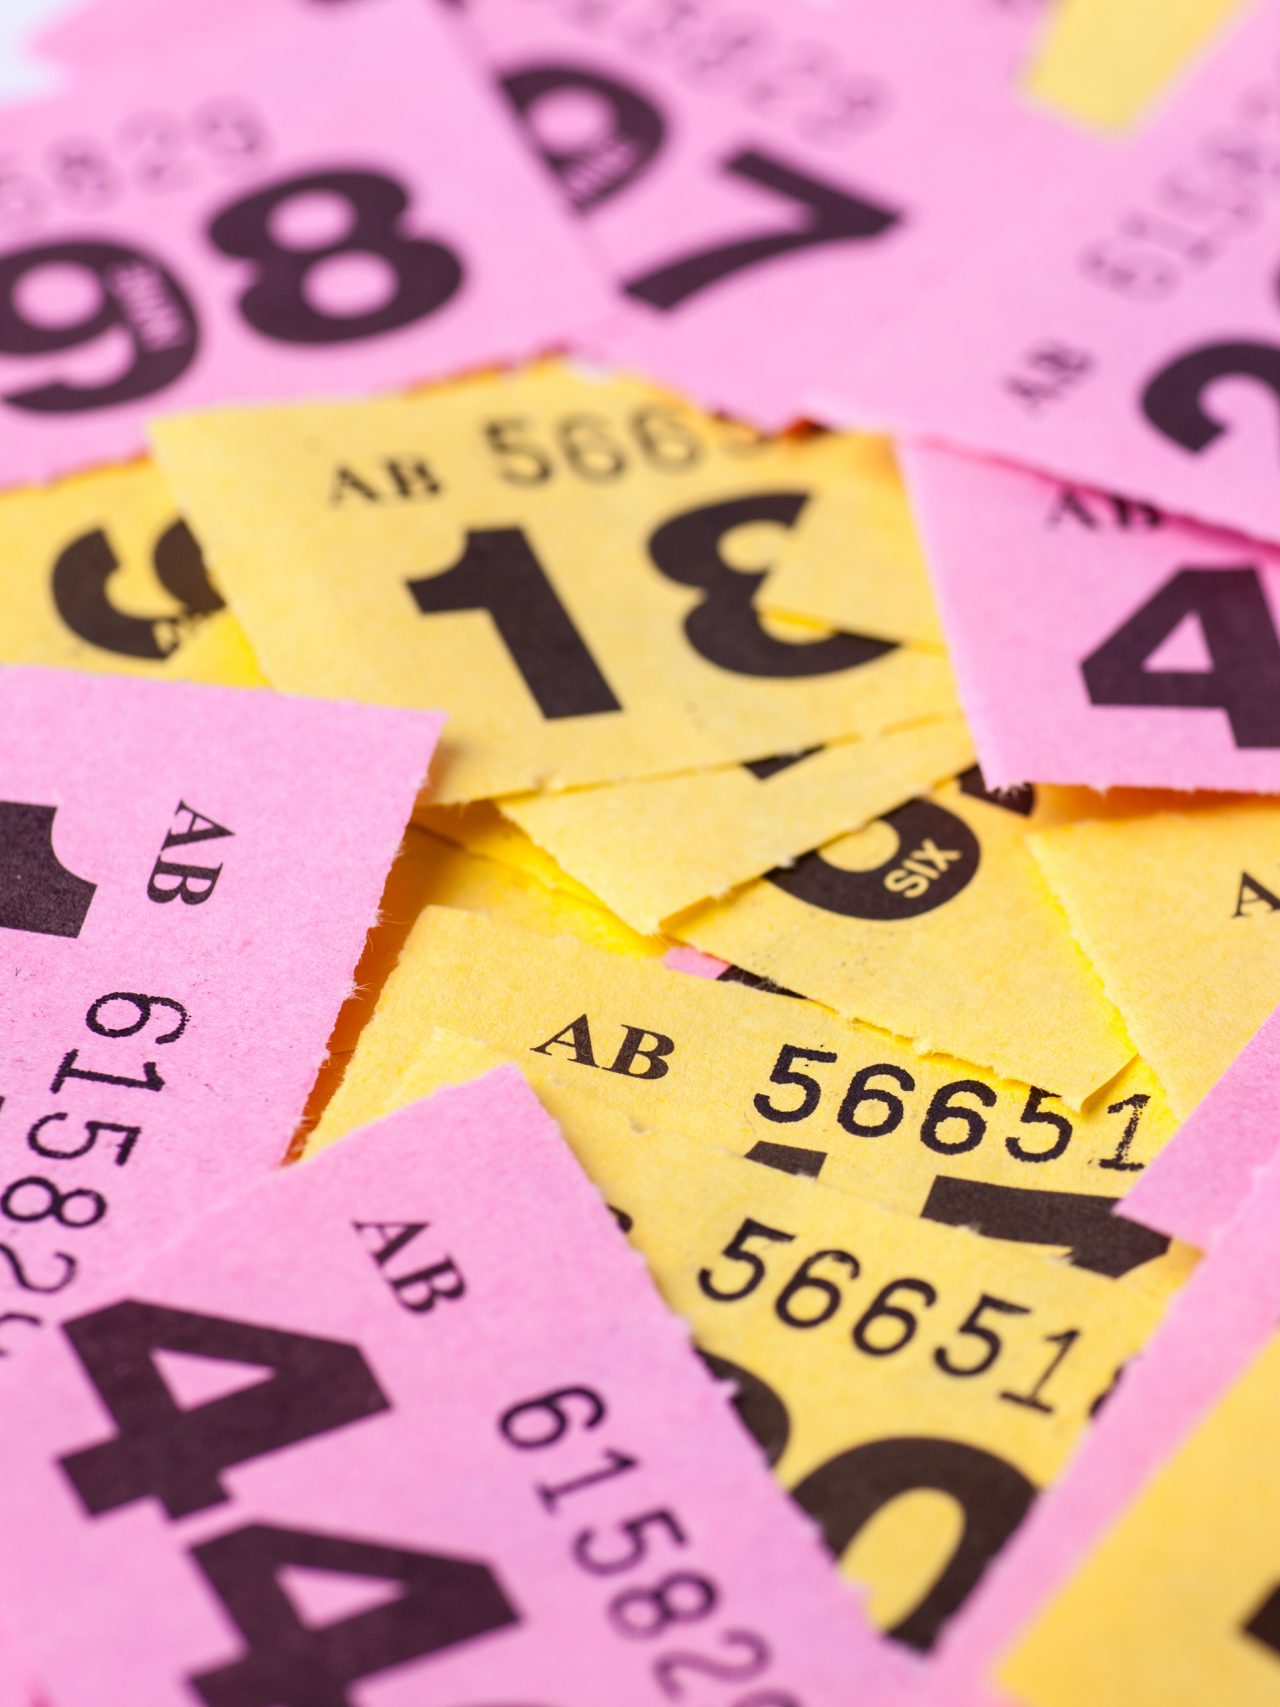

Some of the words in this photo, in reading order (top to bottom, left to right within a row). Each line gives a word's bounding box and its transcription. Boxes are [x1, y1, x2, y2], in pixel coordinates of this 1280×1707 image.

[327, 456, 443, 507] AB
[146, 799, 236, 906] AB
[883, 838, 962, 899] SIX
[530, 1013, 676, 1080] AB
[752, 1042, 1152, 1172] 56651
[0, 991, 191, 1358] 61582
[352, 1217, 467, 1316] AB
[697, 1217, 1130, 1418] 56651
[497, 1385, 805, 1707] 61582
